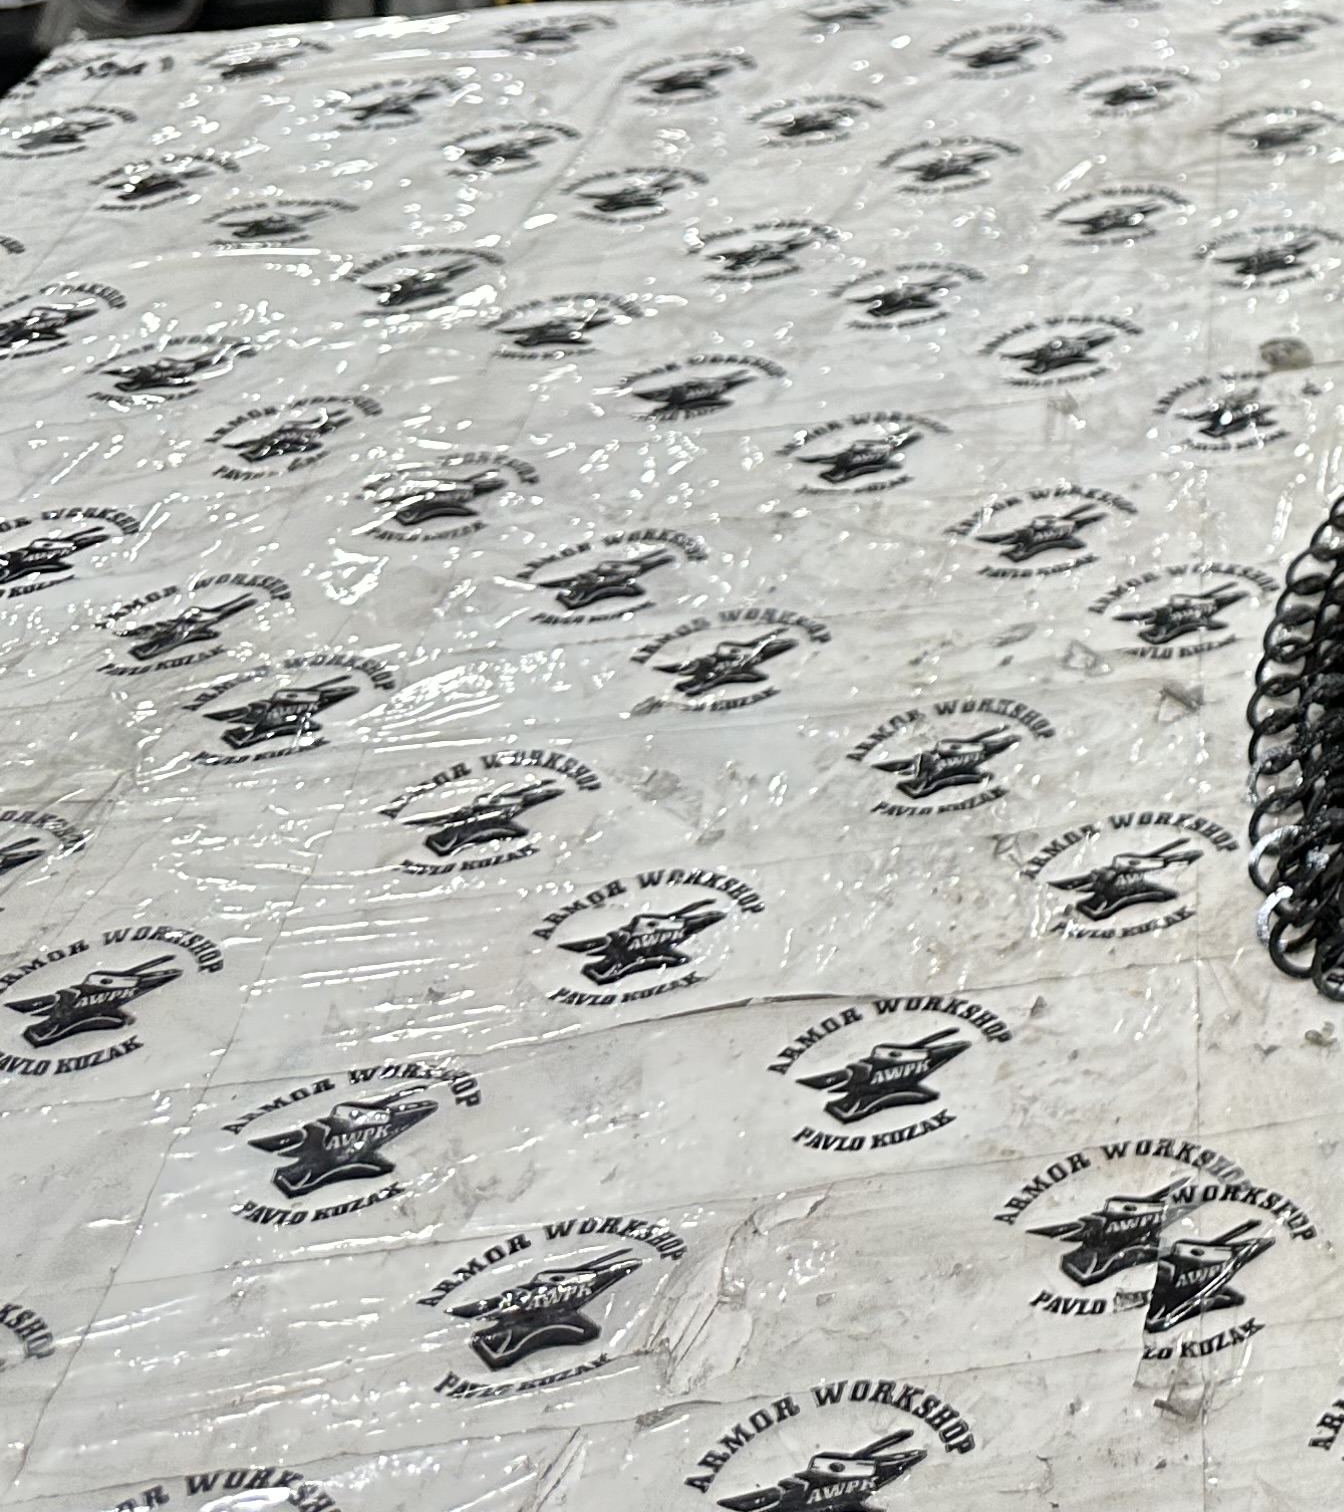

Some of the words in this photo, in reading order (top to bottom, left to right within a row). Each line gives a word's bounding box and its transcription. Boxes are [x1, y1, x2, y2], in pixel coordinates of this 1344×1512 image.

[933, 698, 1056, 739] WORKSHOP
[1108, 811, 1240, 854] WORKSHOP
[531, 879, 628, 942] ARMOR
[636, 868, 766, 915] WORKSHOP
[0, 939, 89, 994] RMOR
[102, 925, 224, 975] WORKSHOP
[628, 928, 686, 951] AWPK
[74, 988, 136, 1008] AWPK
[546, 986, 617, 1006] PAVLO
[0, 1051, 51, 1075] AVLO
[54, 1035, 144, 1075] KOZAK
[767, 1007, 864, 1076] ARMOR
[873, 996, 1013, 1043] WORKSHOP
[870, 1059, 932, 1084] AWPK
[221, 1078, 336, 1136] ARMOR
[324, 1123, 393, 1151] AWPK
[792, 1126, 866, 1152] PAVLO
[869, 1108, 957, 1150] KOZAK
[312, 1181, 403, 1222] KOZAK
[993, 1152, 1092, 1226] ARMOR
[416, 1232, 532, 1308] ARMOR
[542, 1215, 688, 1263] WORKSHOP
[1029, 1289, 1108, 1315] PAVLO
[1180, 1317, 1266, 1359] KOZAK
[683, 1393, 802, 1495] ARMOR
[810, 1377, 977, 1457] WORKSHOP
[803, 1474, 882, 1505] AWPK
